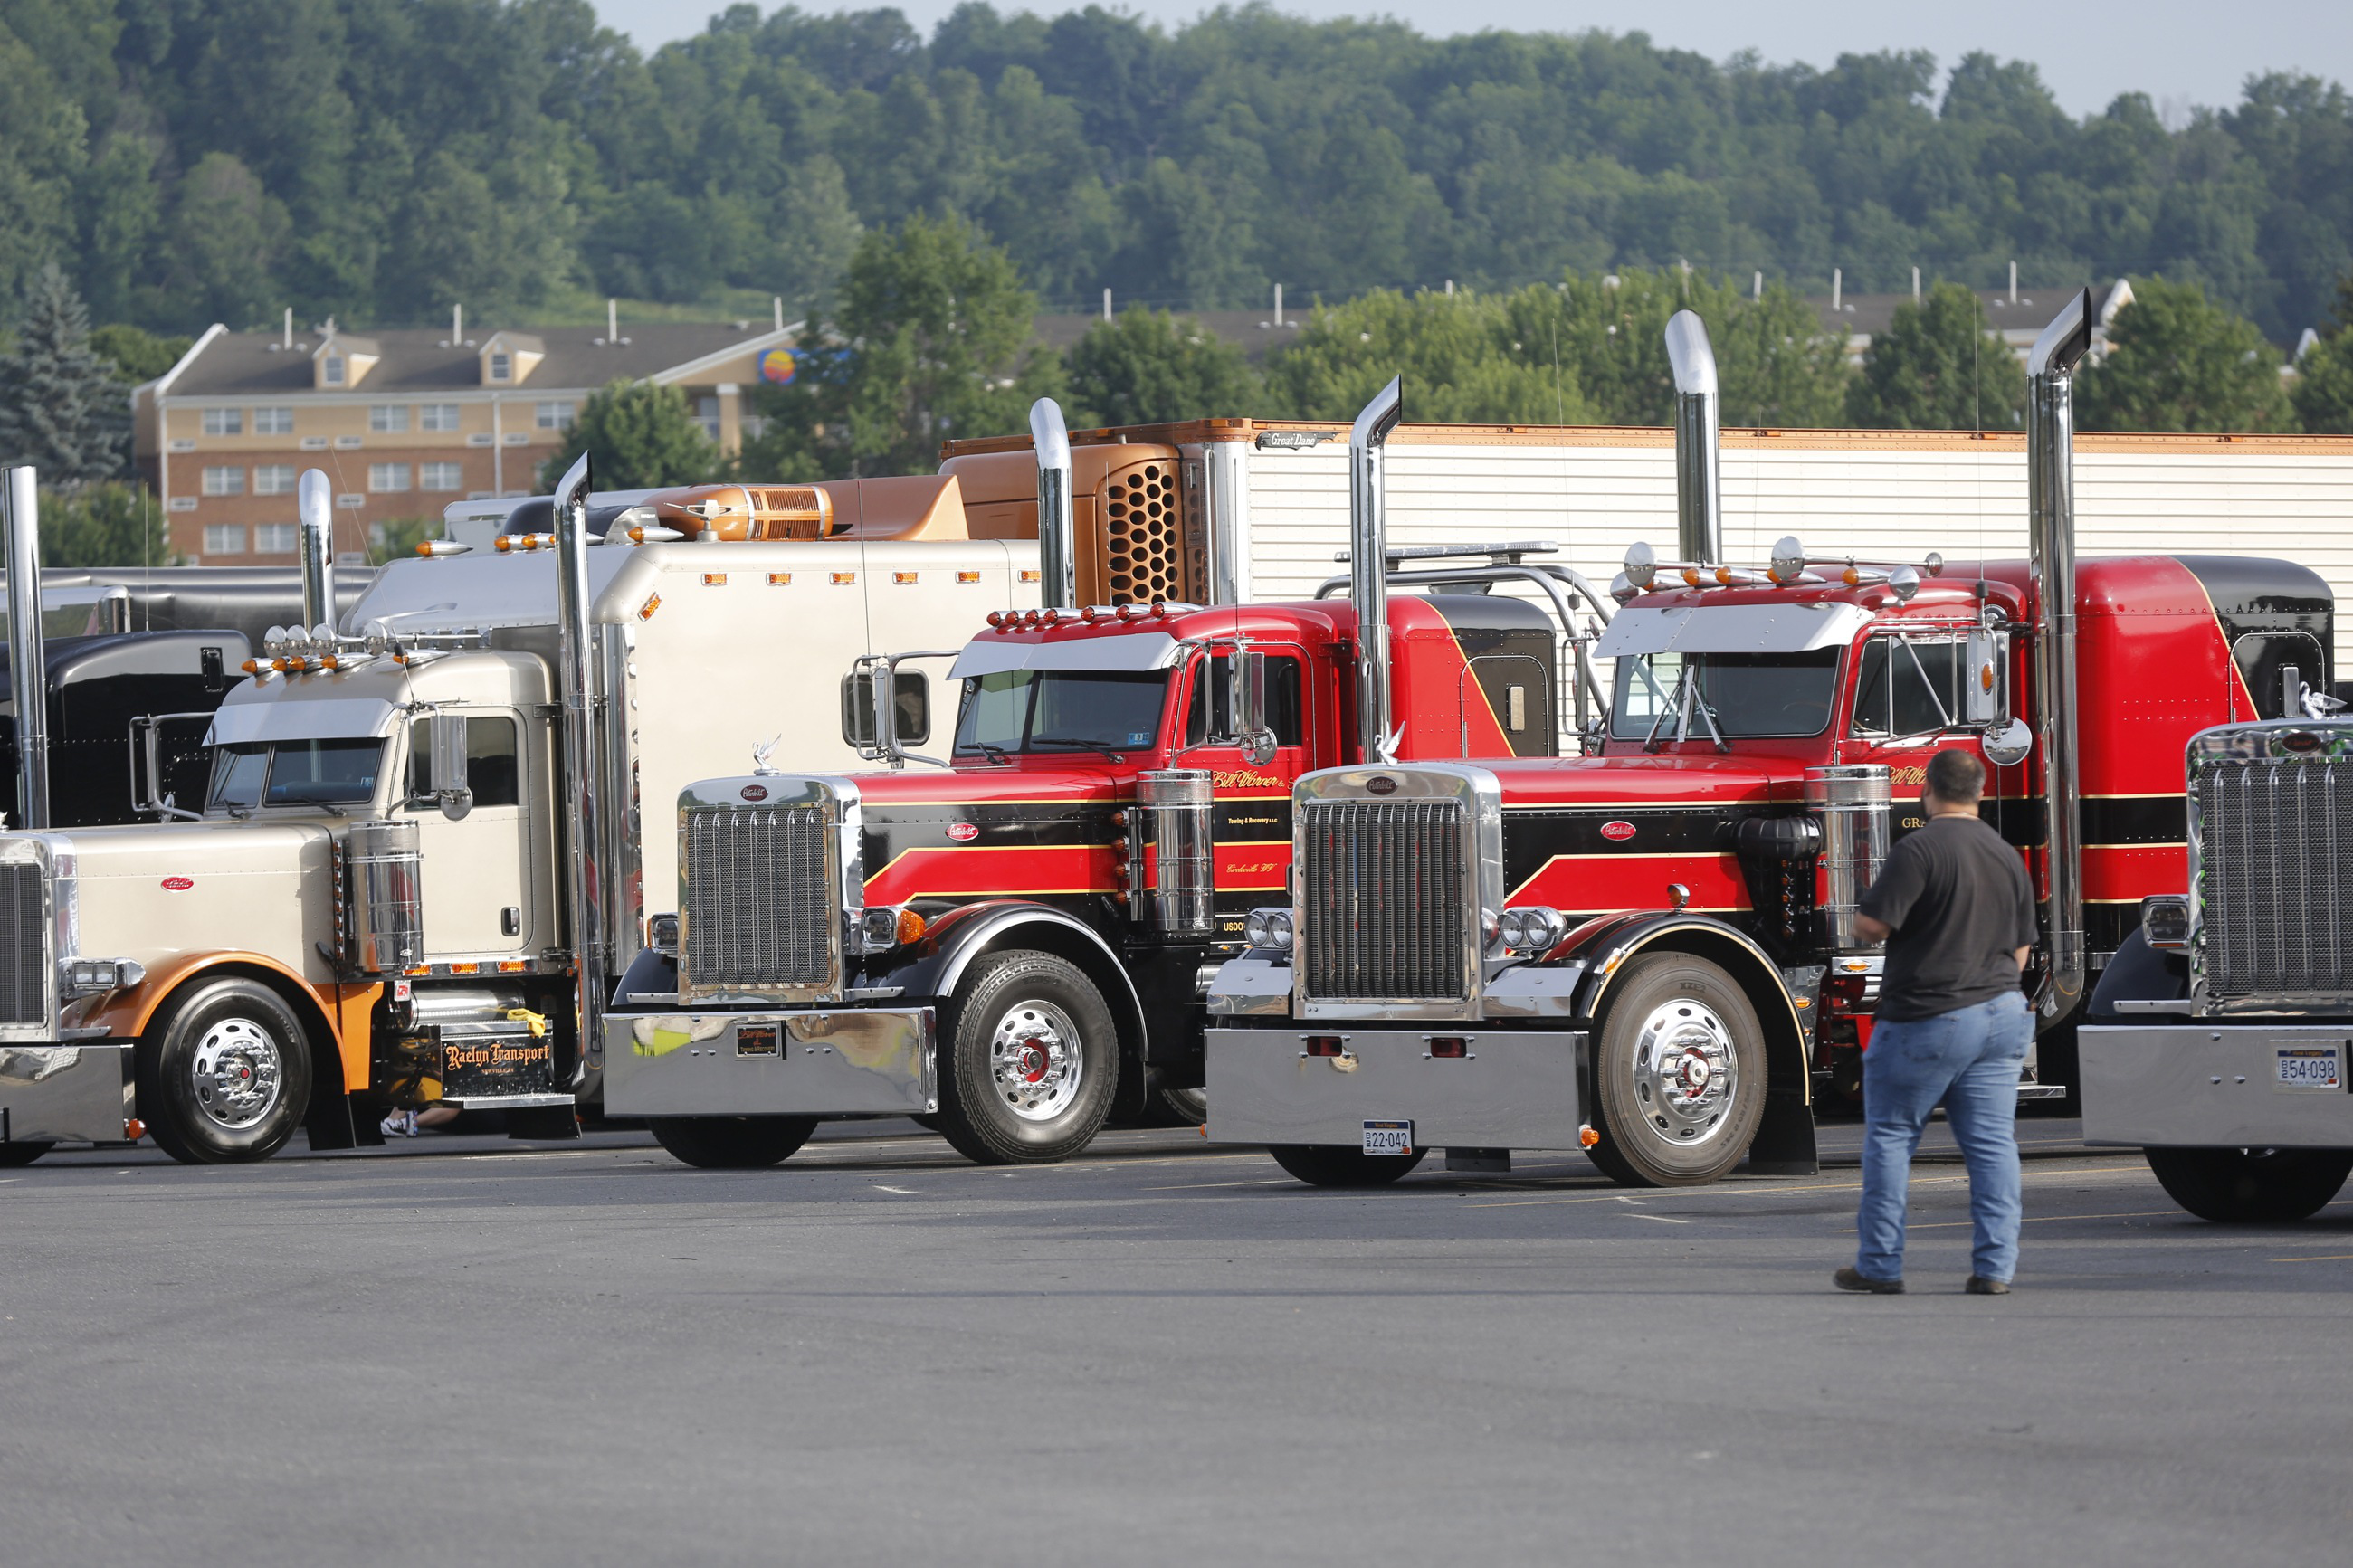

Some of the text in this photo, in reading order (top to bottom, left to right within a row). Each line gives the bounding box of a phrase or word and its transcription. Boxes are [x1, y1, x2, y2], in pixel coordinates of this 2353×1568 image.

[1271, 432, 1316, 445] Great Dane
[1214, 770, 1237, 788] Bill
[1224, 921, 1246, 932] USDO
[445, 1043, 549, 1070] Raelyn Transport
